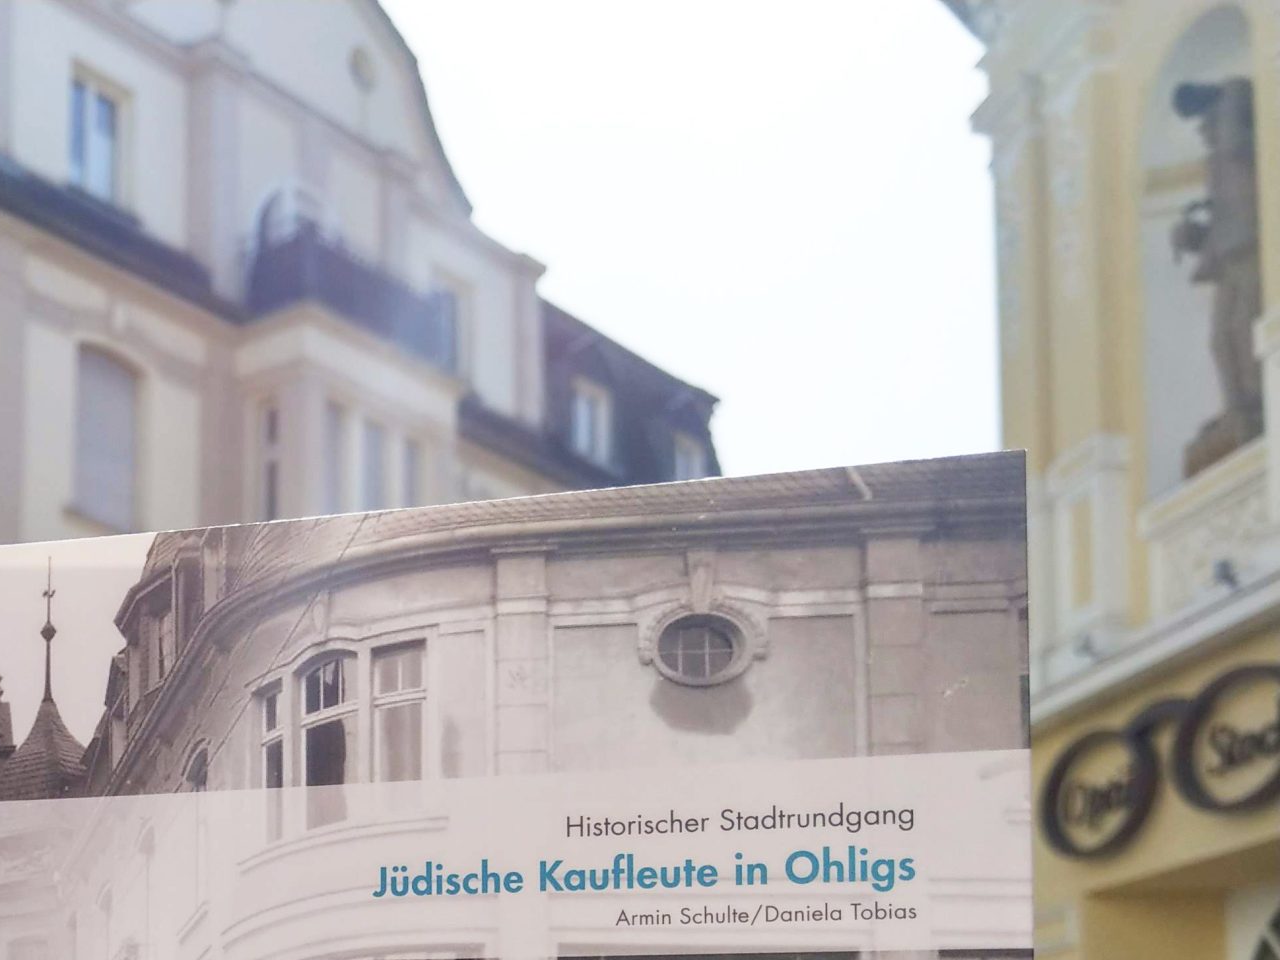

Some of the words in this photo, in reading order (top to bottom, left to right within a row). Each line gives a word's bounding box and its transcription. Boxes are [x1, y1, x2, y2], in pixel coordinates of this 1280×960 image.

[566, 809, 710, 838] Historischer
[720, 801, 915, 833] Stadtrundgang
[372, 859, 524, 898] Jüdische
[539, 853, 718, 893] Kaufleute
[734, 852, 768, 886] in
[784, 845, 916, 893] Ohligs
[616, 909, 672, 927] Armin
[679, 902, 842, 926] Schulte/Daniela
[850, 901, 917, 921] Tobias
